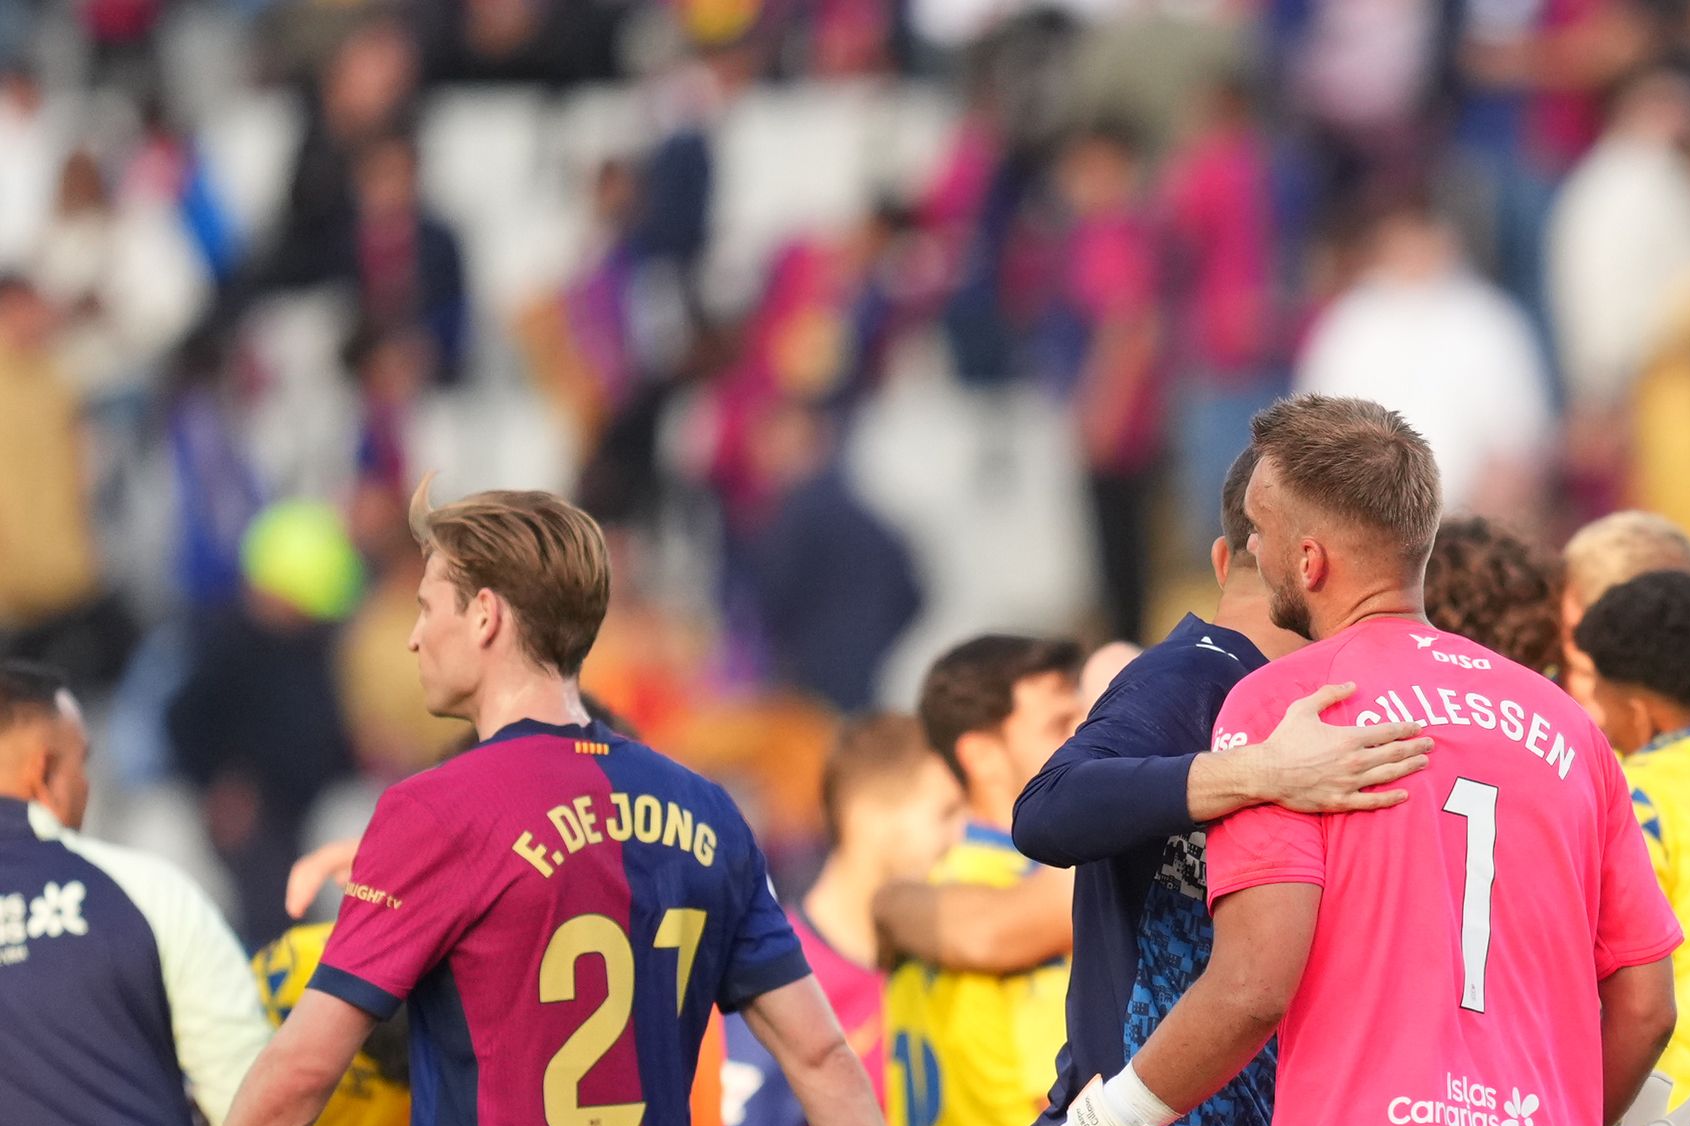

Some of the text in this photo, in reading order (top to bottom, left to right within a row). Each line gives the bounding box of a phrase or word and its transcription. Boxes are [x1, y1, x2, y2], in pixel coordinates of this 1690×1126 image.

[511, 792, 718, 879] F. DE JONG
[1442, 775, 1499, 1014] 1
[1447, 1072, 1497, 1110] Islas
